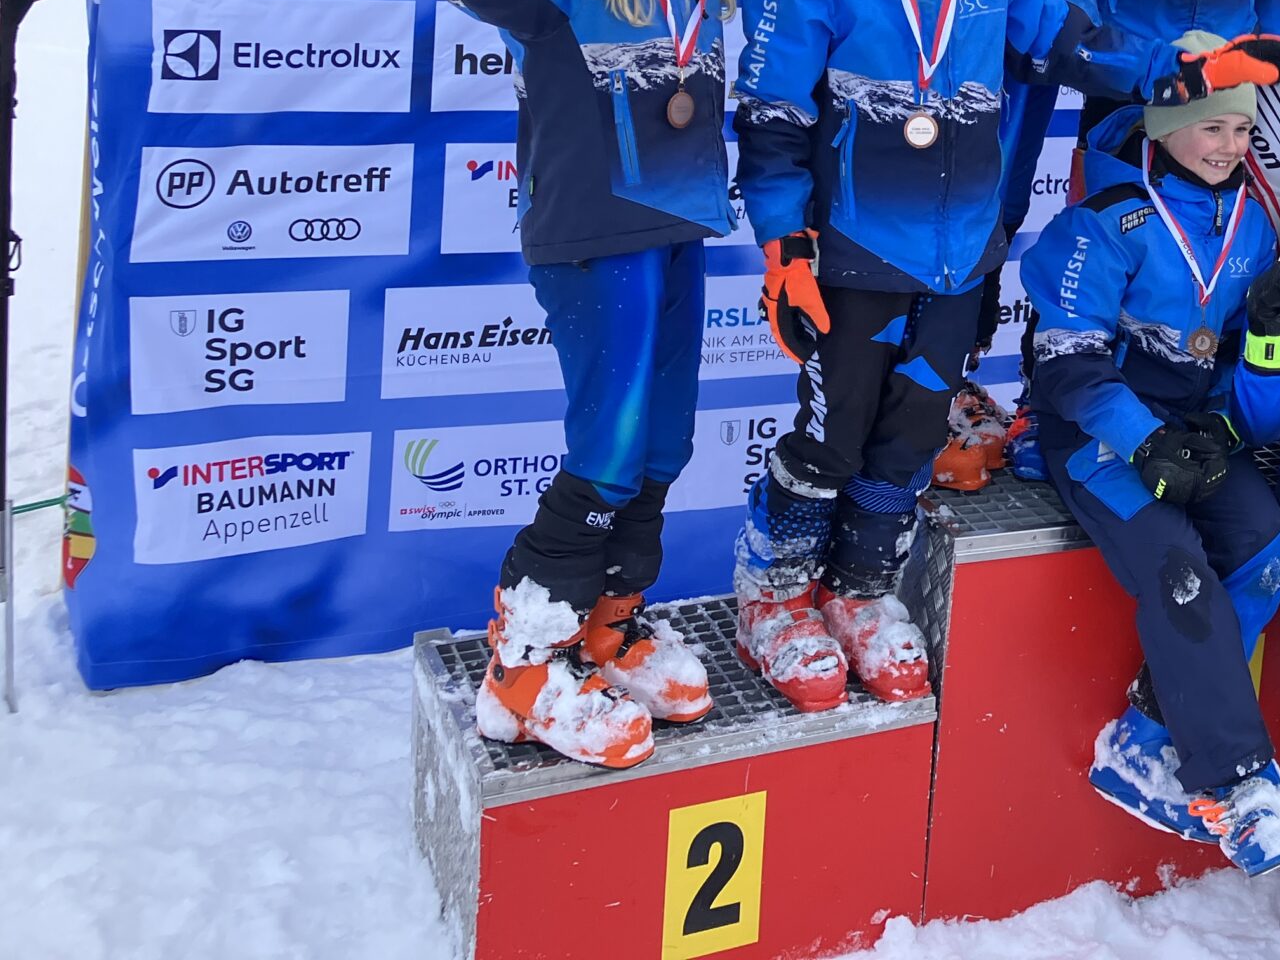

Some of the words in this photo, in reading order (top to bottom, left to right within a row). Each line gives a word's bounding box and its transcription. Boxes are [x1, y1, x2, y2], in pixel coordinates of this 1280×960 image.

[233, 42, 401, 69] Electrolux
[226, 166, 393, 196] Autotreff
[1228, 257, 1250, 274] SSC
[207, 307, 245, 334] IG
[204, 334, 306, 366] Sport
[397, 326, 473, 354] Hans
[731, 336, 756, 346] AM
[396, 352, 492, 367] KÜCHENBAU
[204, 368, 255, 393] SG
[748, 417, 777, 441] IG
[182, 450, 354, 487] INTERSPORT
[196, 478, 337, 514] BAUMANN
[1153, 477, 1167, 499] LEKI
[202, 502, 329, 543] Appenzell
[408, 505, 436, 515] swiss
[421, 509, 462, 520] olympic
[467, 508, 505, 517] APPROVED
[682, 821, 745, 936] 2
